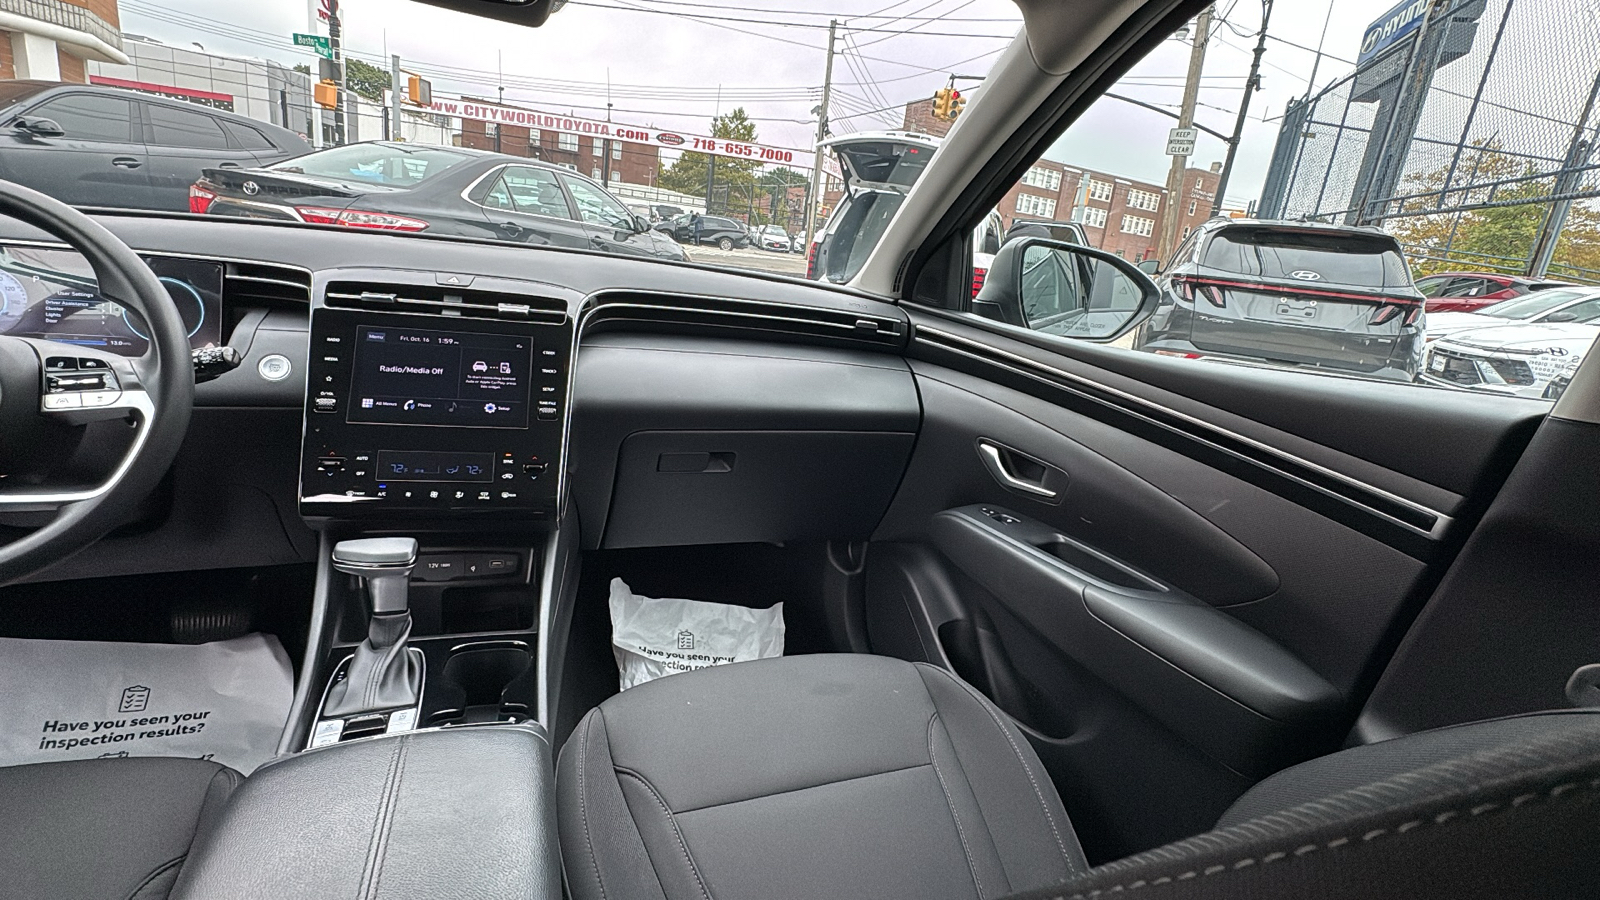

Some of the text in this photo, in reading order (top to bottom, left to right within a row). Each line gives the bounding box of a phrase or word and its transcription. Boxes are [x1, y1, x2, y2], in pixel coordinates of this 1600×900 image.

[1382, 0, 1430, 40] HYUND
[421, 101, 649, 141] WW.CITYWORLDTOYOTA.com
[379, 365, 430, 374] Radio/Media
[662, 660, 692, 671] ection
[42, 711, 211, 733] Have you seen your
[39, 723, 205, 750] inspection results?
